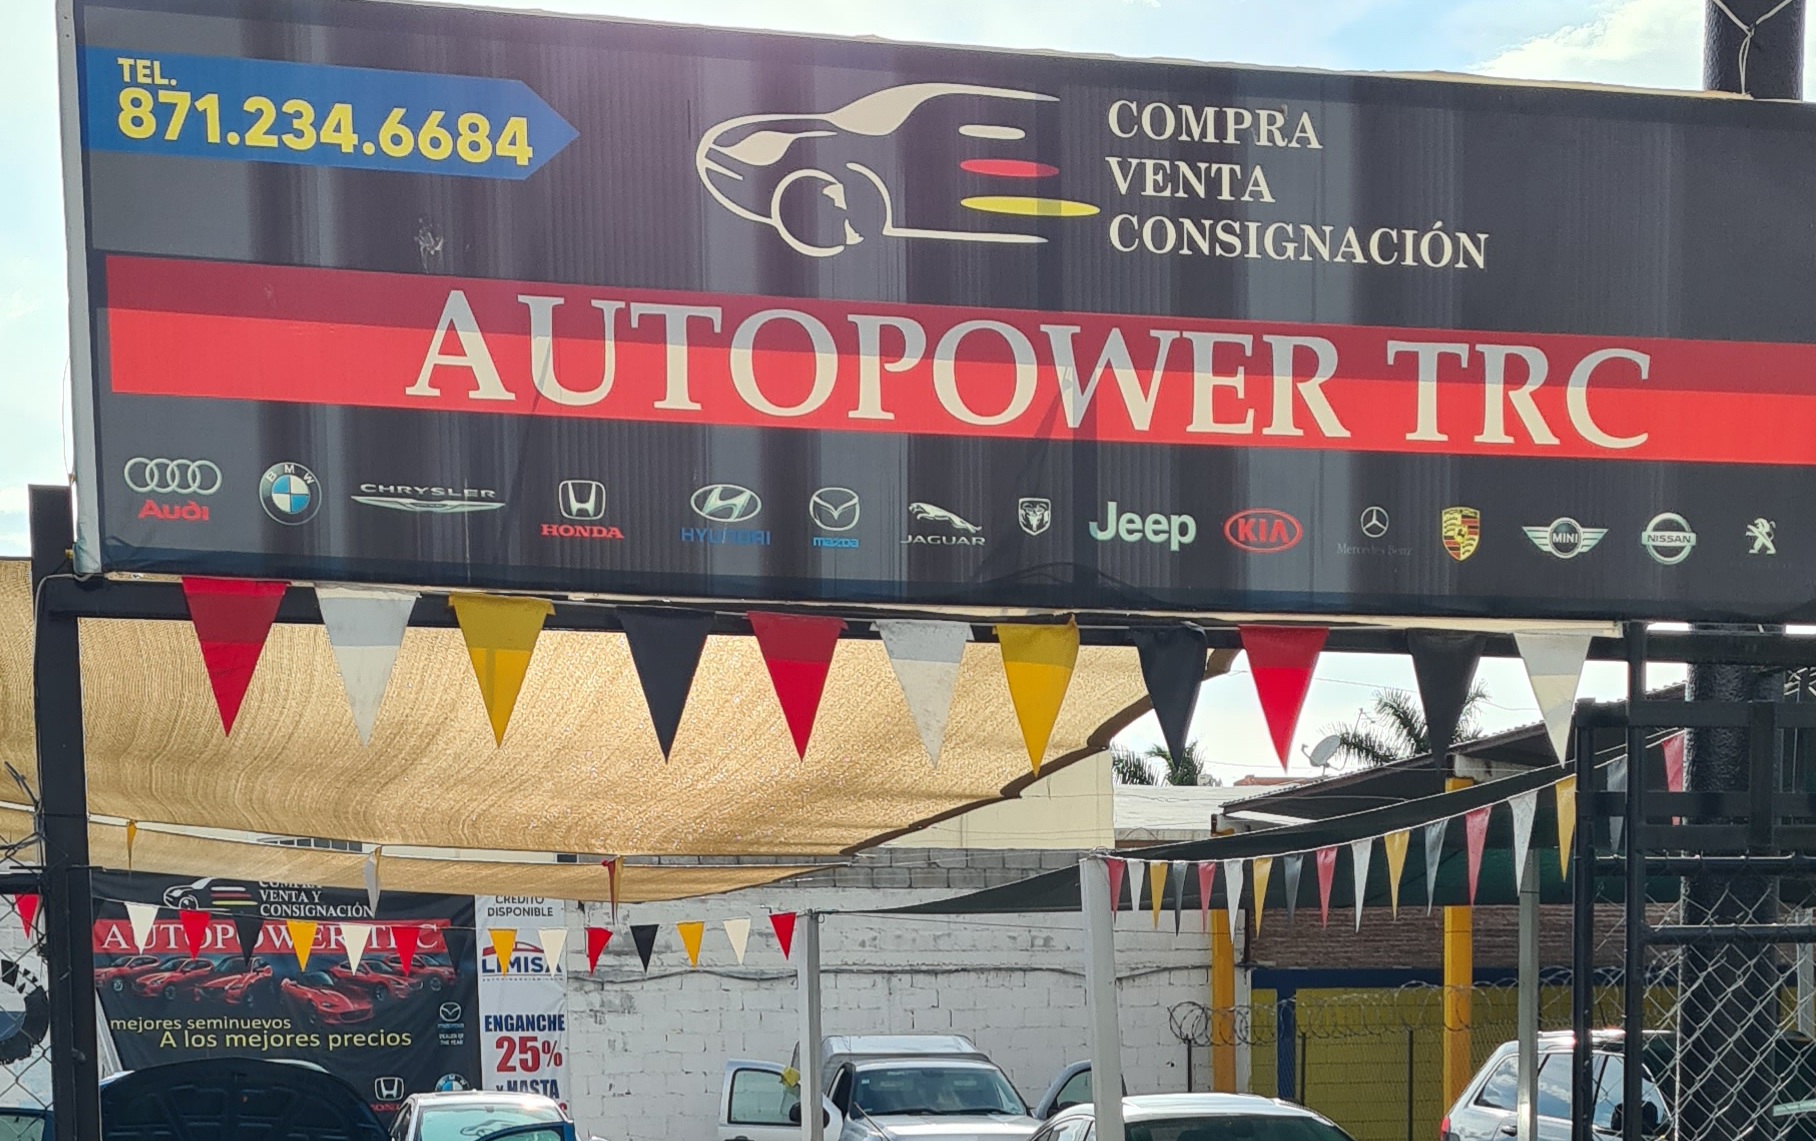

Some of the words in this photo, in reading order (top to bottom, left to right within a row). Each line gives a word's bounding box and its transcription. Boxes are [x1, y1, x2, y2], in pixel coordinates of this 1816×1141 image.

[117, 57, 177, 87] TEL.
[117, 88, 534, 166] 871.234.6684
[1107, 99, 1324, 151] COMPRA
[1104, 155, 1276, 204] VENTA
[1108, 214, 1490, 271] CONSIGNACIÓN
[405, 288, 1352, 439] AUTOPOWER
[1386, 339, 1652, 450] TRC
[266, 464, 315, 485] BMW
[359, 483, 497, 499] CHRYSLER
[138, 499, 210, 521] Audi
[540, 523, 625, 539] HONDA
[1088, 501, 1197, 551] Jeep
[1236, 517, 1290, 544] KIA
[900, 534, 986, 547] JAGUAR
[1551, 532, 1579, 545] MINI
[1646, 533, 1692, 545] NISSAN
[259, 889, 309, 903] VENTA
[311, 890, 322, 903] Y
[260, 902, 375, 918] CONSIGNACIÓN
[487, 906, 554, 917] DISPONIBLE
[366, 924, 438, 950] TC
[110, 1016, 182, 1033] mejores
[186, 1016, 292, 1030] seminuevos
[484, 1014, 565, 1032] ENGANCHE
[160, 1031, 177, 1048] A
[184, 1029, 218, 1048] los
[225, 1030, 321, 1051] mejores
[328, 1029, 412, 1050] precios
[495, 1035, 563, 1073] 25%
[507, 1078, 560, 1099] HASTA
